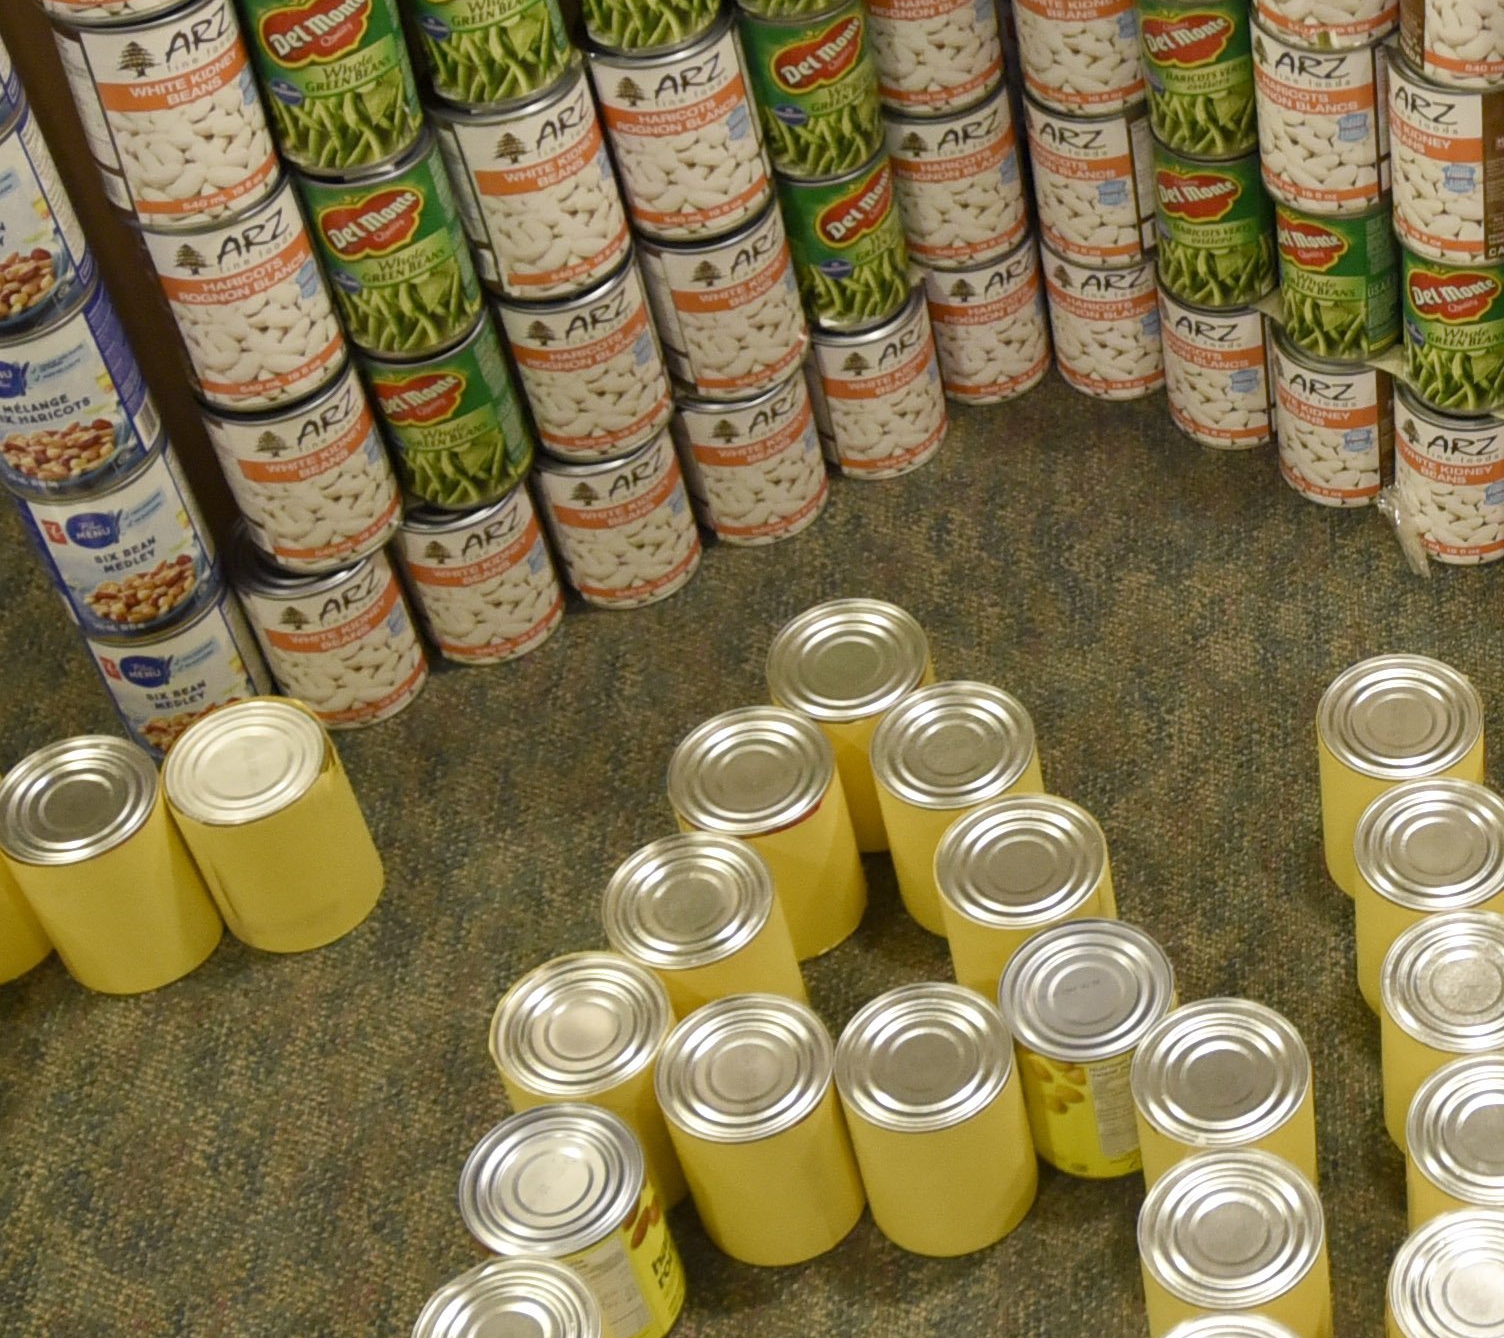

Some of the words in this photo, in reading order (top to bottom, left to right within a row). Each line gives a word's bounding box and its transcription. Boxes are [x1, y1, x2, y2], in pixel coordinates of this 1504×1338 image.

[269, 32, 312, 57] Del
[216, 207, 289, 263] ARZ
[1413, 286, 1449, 305] Del
[1448, 276, 1496, 301] Monte
[1427, 435, 1497, 456] ARZ
